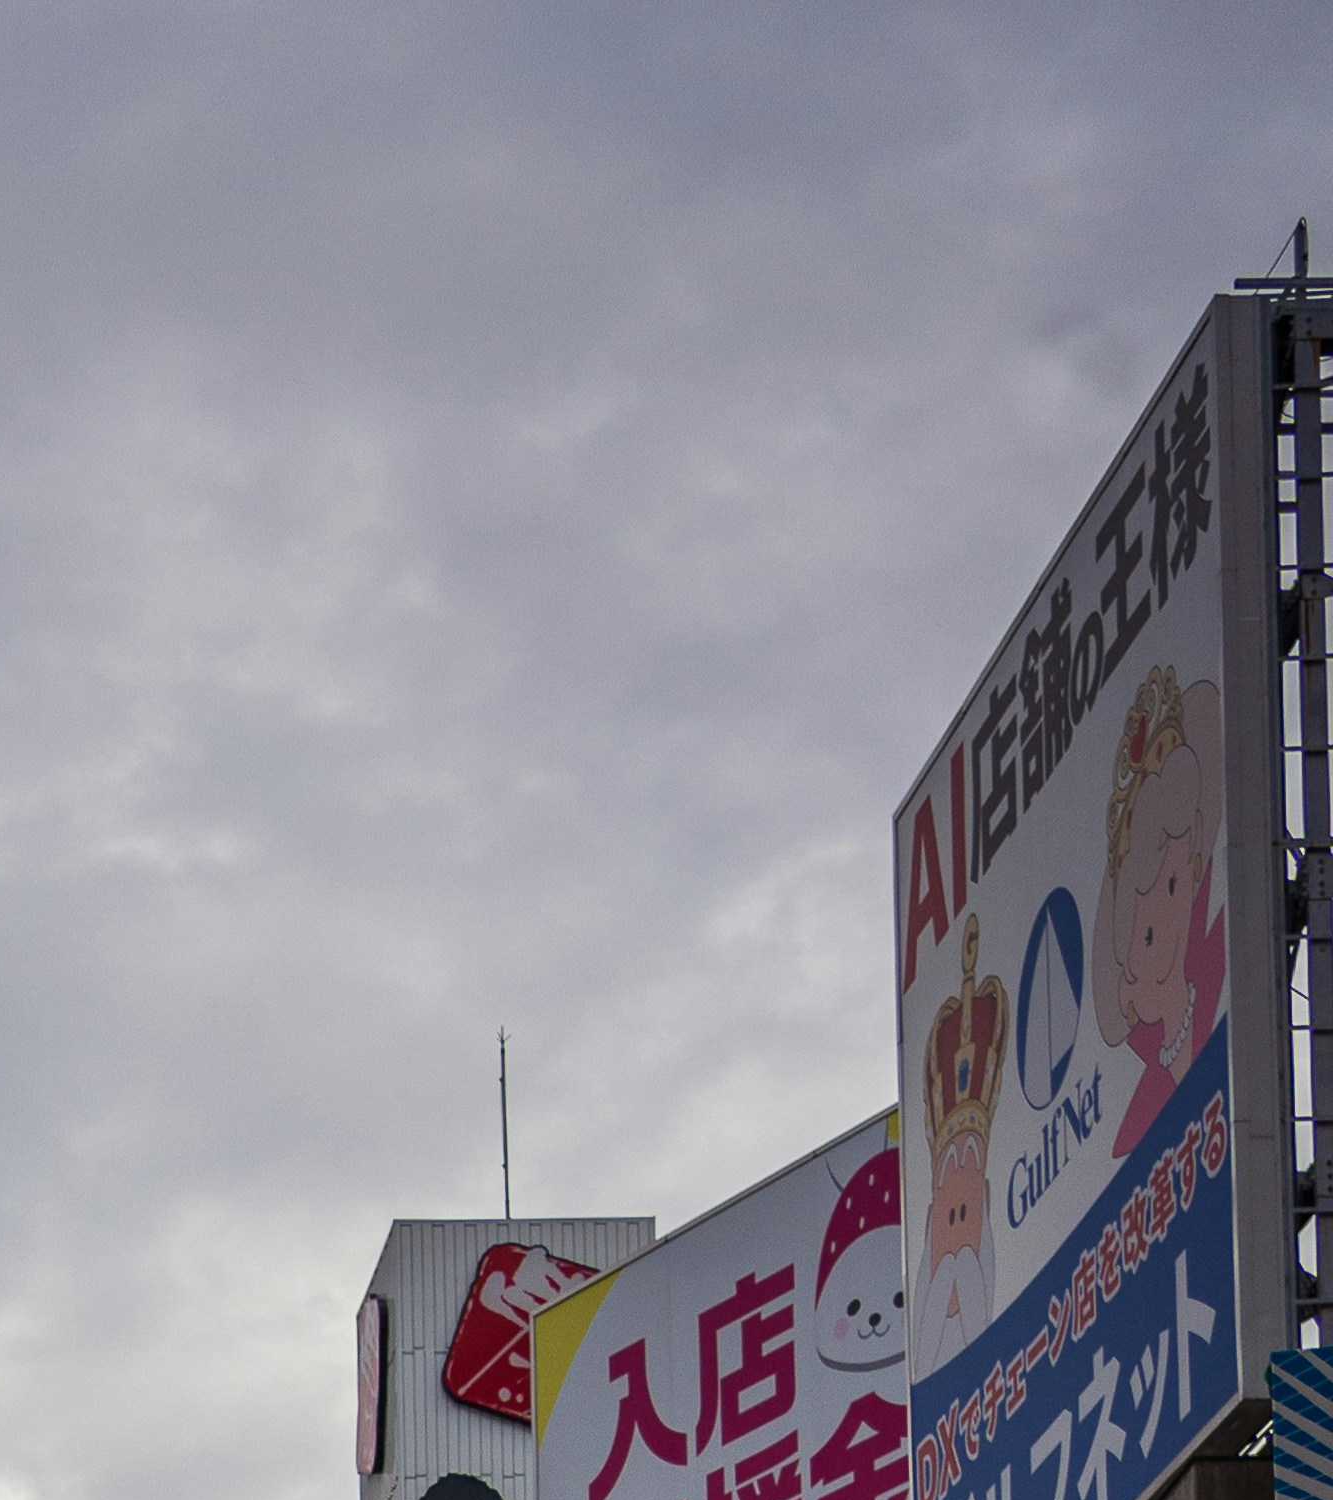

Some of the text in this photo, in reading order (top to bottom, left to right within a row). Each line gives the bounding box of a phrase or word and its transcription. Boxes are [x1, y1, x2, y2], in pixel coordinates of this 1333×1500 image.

[902, 362, 1214, 998] AI店舗の王様
